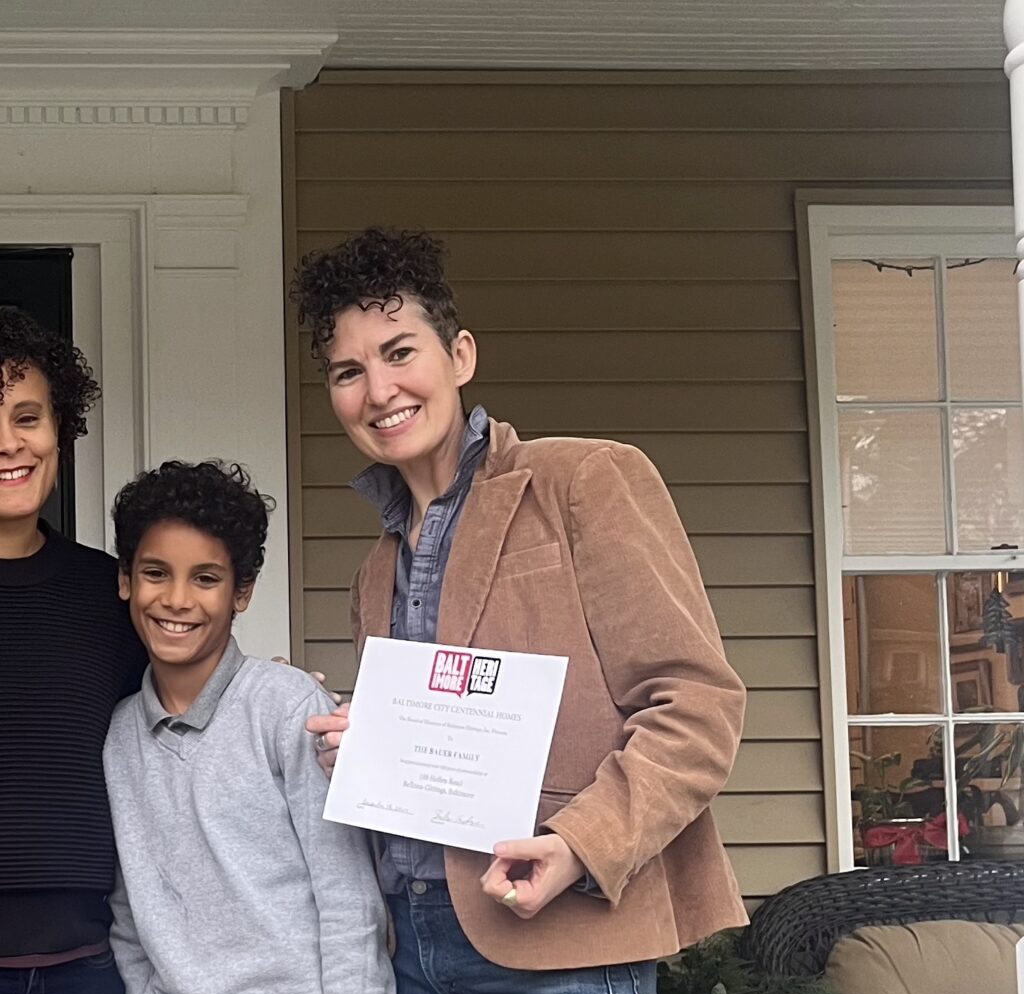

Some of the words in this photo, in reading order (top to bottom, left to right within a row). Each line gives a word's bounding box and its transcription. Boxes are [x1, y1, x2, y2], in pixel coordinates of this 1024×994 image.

[434, 652, 471, 676] BALT
[472, 658, 499, 677] HERI
[431, 674, 464, 691] IMORE
[470, 675, 495, 693] TAGE
[392, 697, 432, 710] BALTIMORE
[433, 703, 450, 713] CITY
[451, 705, 494, 718] CENTENNIAL
[496, 711, 522, 722] HOMES
[414, 745, 427, 754] THE
[453, 751, 480, 762] FAMILY
